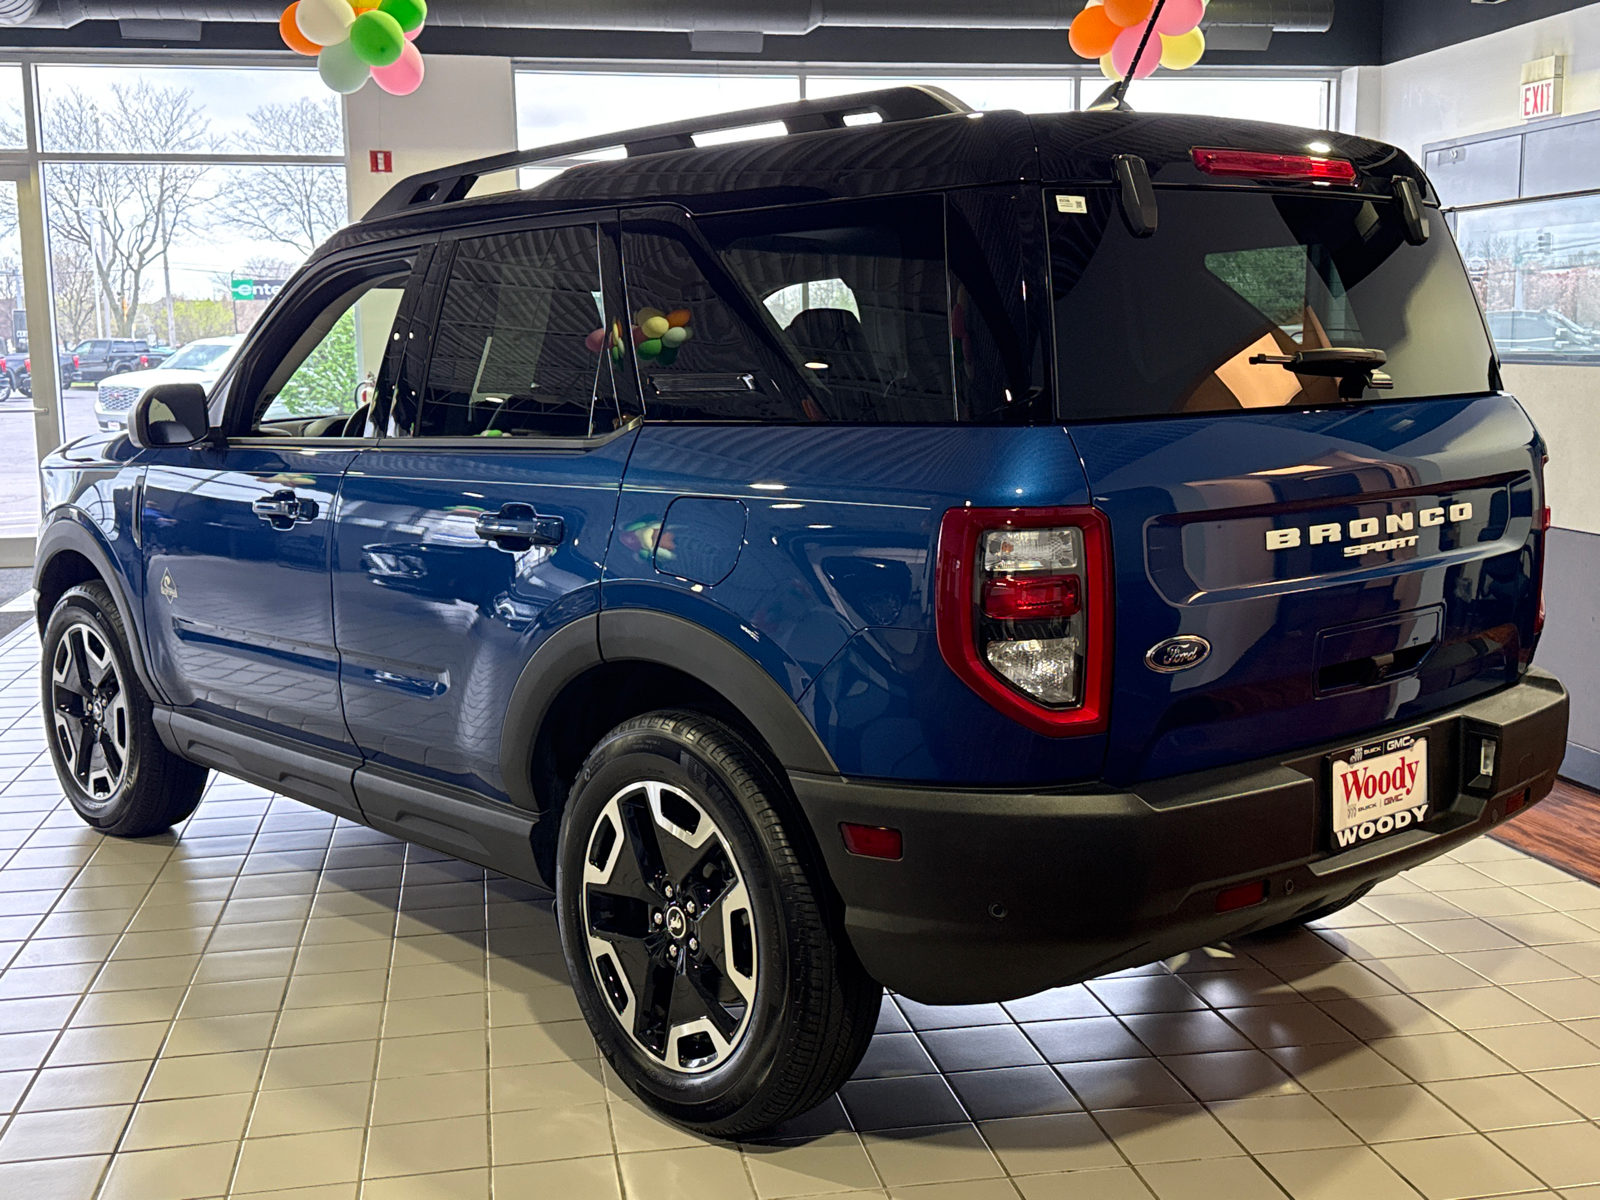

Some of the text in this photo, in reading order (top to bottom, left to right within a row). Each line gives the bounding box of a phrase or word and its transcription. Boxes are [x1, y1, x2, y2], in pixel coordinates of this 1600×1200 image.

[1524, 82, 1552, 116] EXIT
[239, 283, 282, 296] ente
[1265, 502, 1473, 551] BRONCO
[1343, 535, 1419, 557] SPORT
[1163, 643, 1198, 665] Ford
[1363, 735, 1411, 755] BUICK GMC
[1340, 756, 1420, 805] Woody
[1357, 793, 1403, 812] BUICK GMC
[1336, 804, 1429, 848] WOODY
